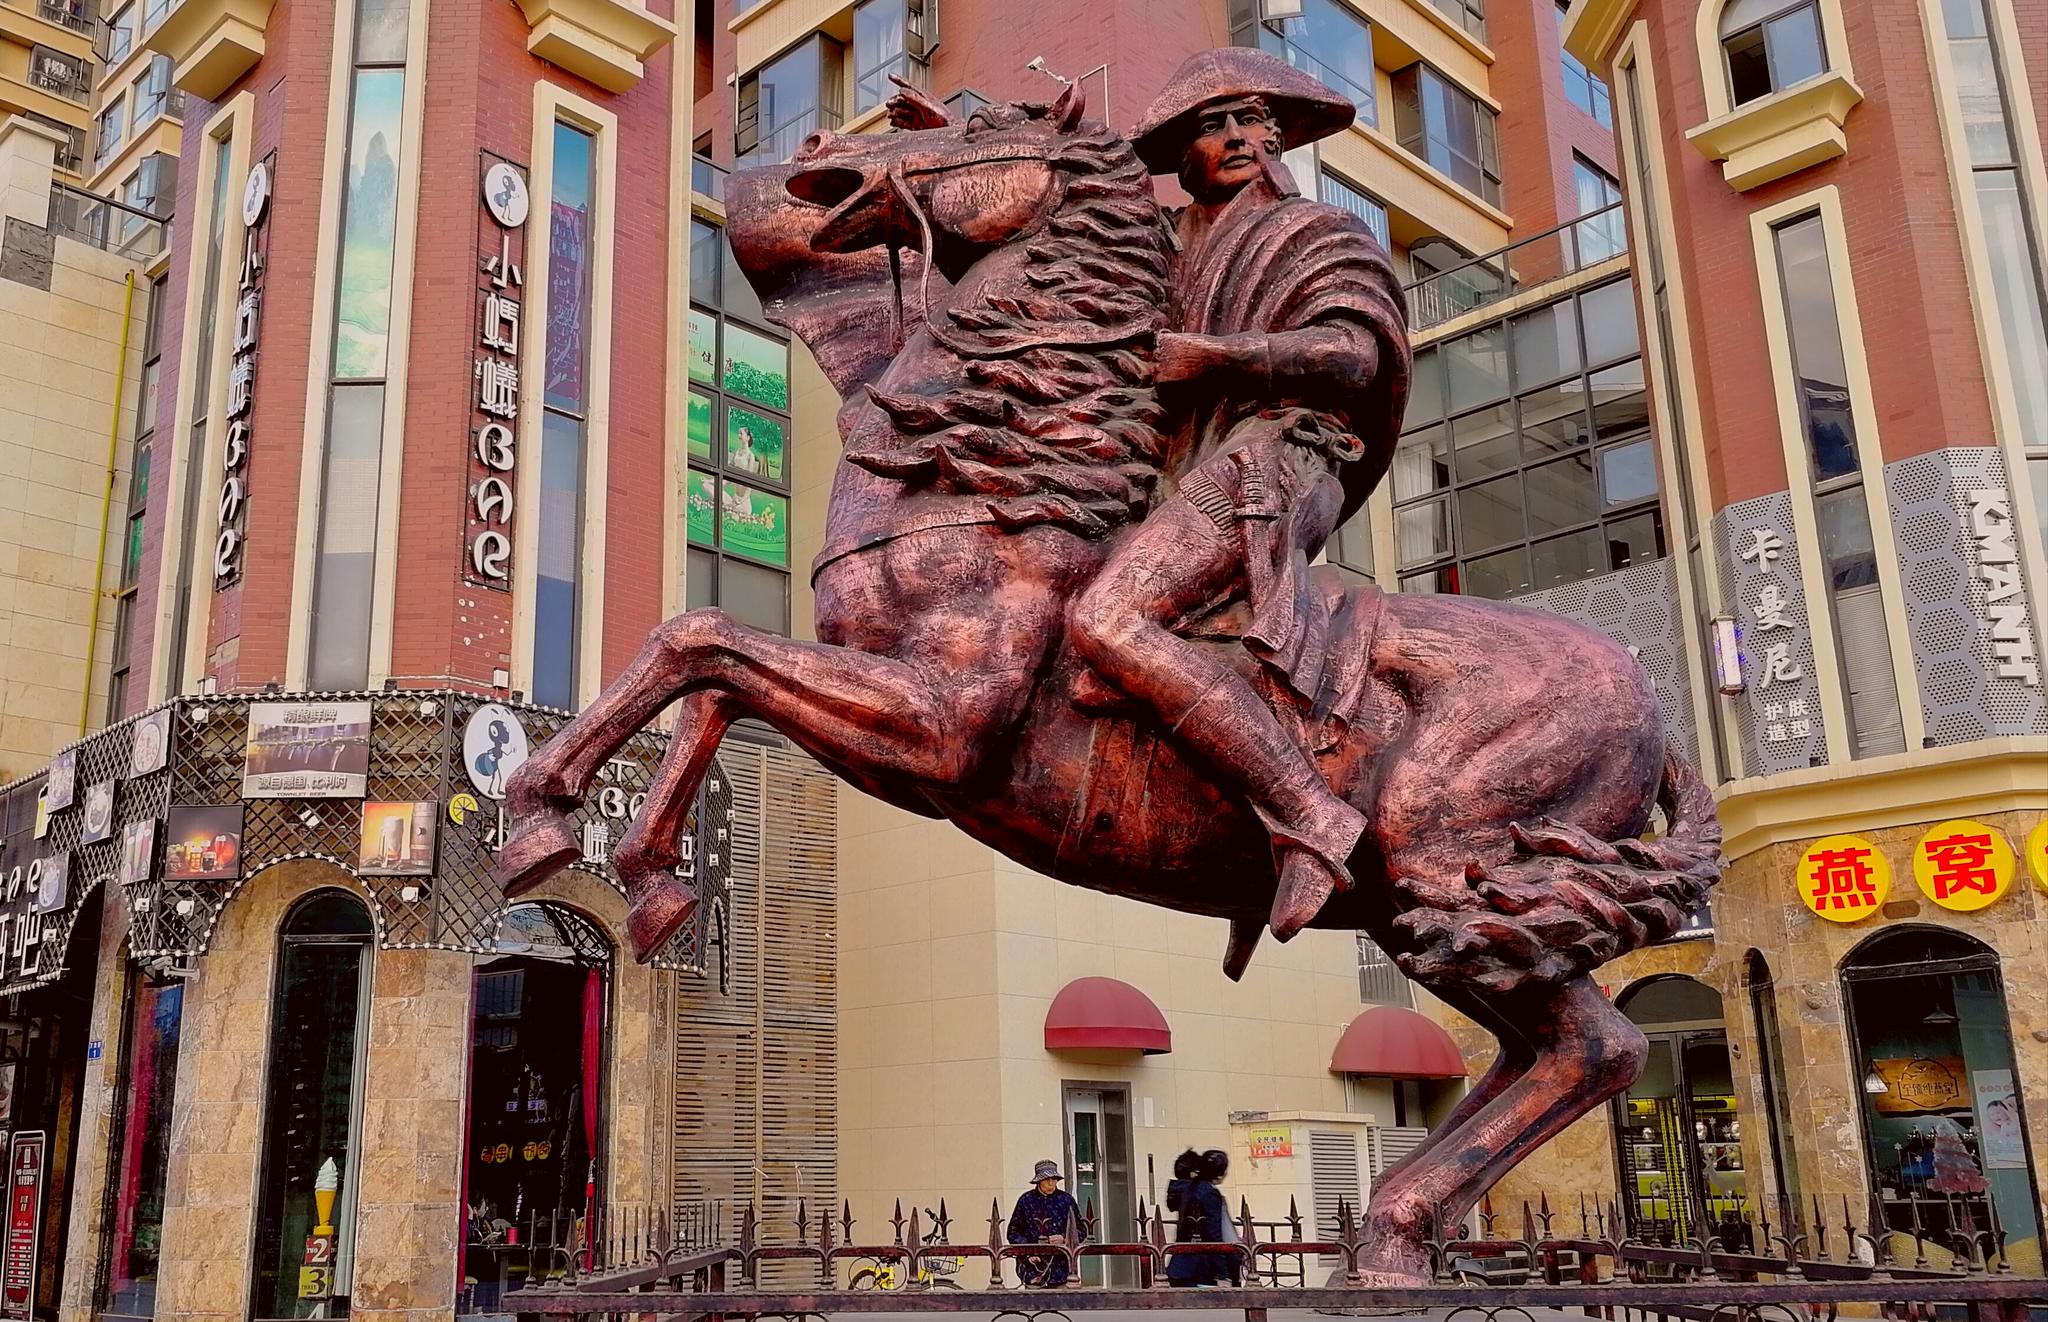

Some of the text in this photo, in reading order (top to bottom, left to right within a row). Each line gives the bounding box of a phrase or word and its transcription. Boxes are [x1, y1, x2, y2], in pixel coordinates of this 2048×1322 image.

[1743, 529, 1802, 689] 卡曼尼
[1764, 698, 1809, 722] 护肤
[1767, 718, 1812, 742] 造型
[311, 1238, 328, 1263] 2
[306, 1268, 326, 1296] 3
